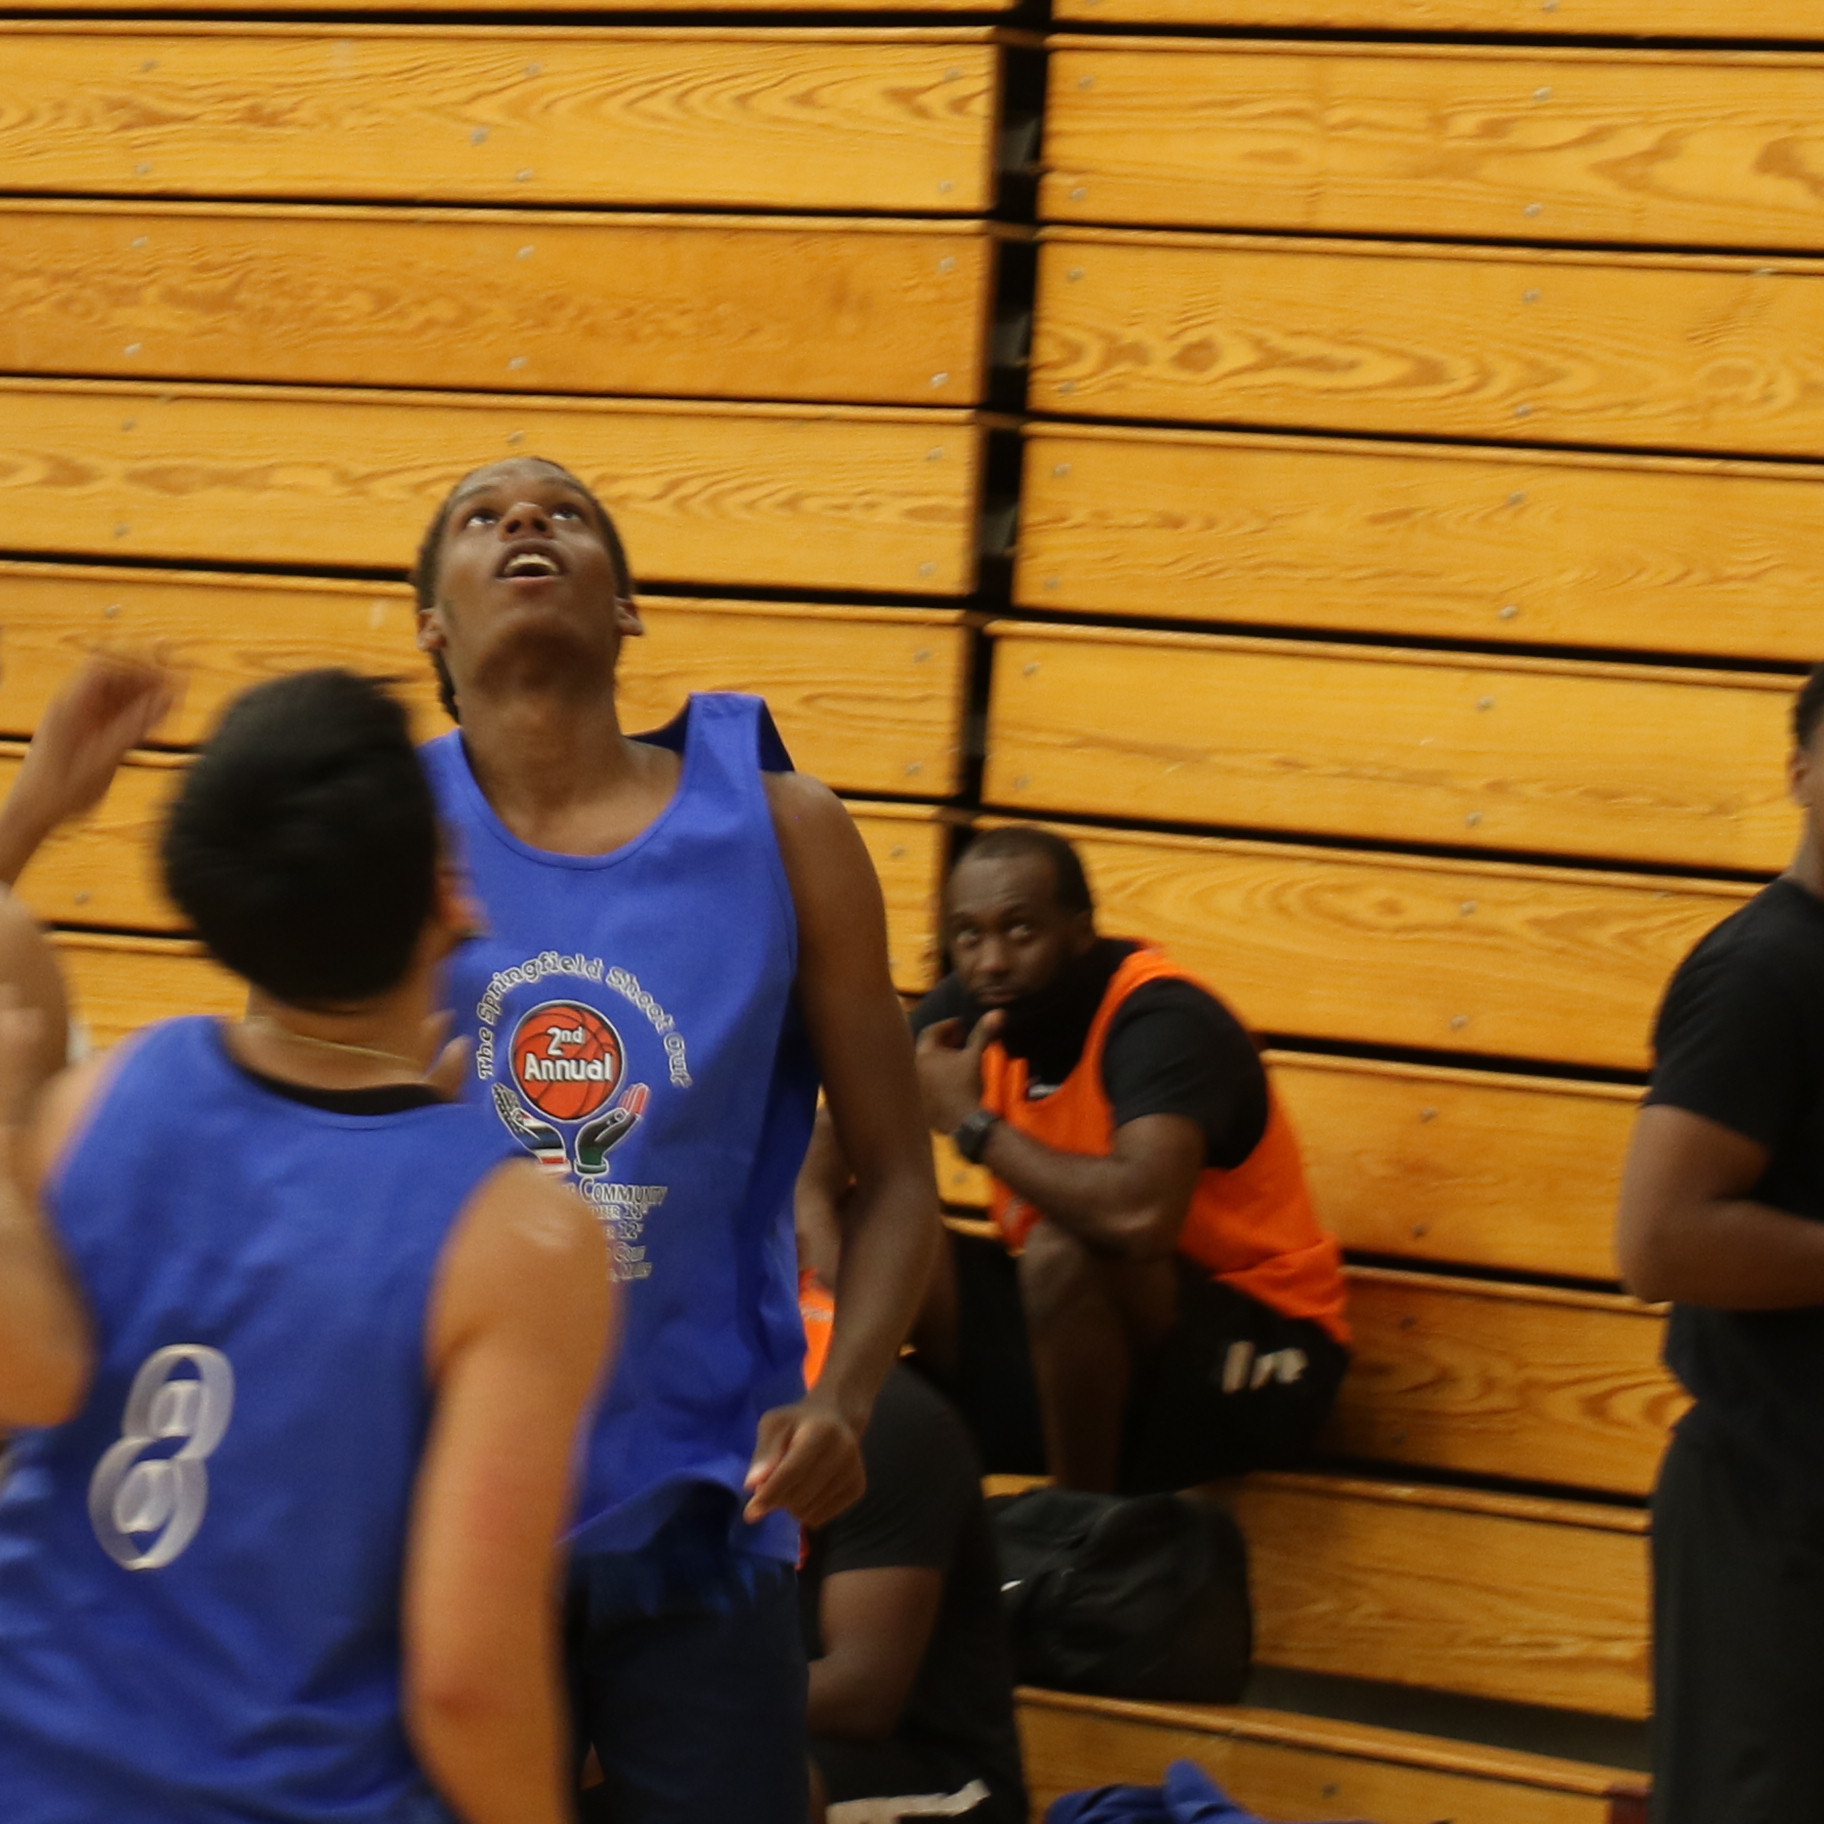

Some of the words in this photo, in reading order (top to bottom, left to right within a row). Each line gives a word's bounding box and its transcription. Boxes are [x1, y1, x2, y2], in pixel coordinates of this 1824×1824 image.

[477, 950, 604, 1026] Springfield
[605, 966, 675, 1036] Shoot
[477, 1026, 495, 1080] The
[524, 1052, 615, 1082] Annual
[546, 1026, 586, 1056] 2nd
[663, 1032, 693, 1089] Out
[88, 1344, 235, 1571] 8
